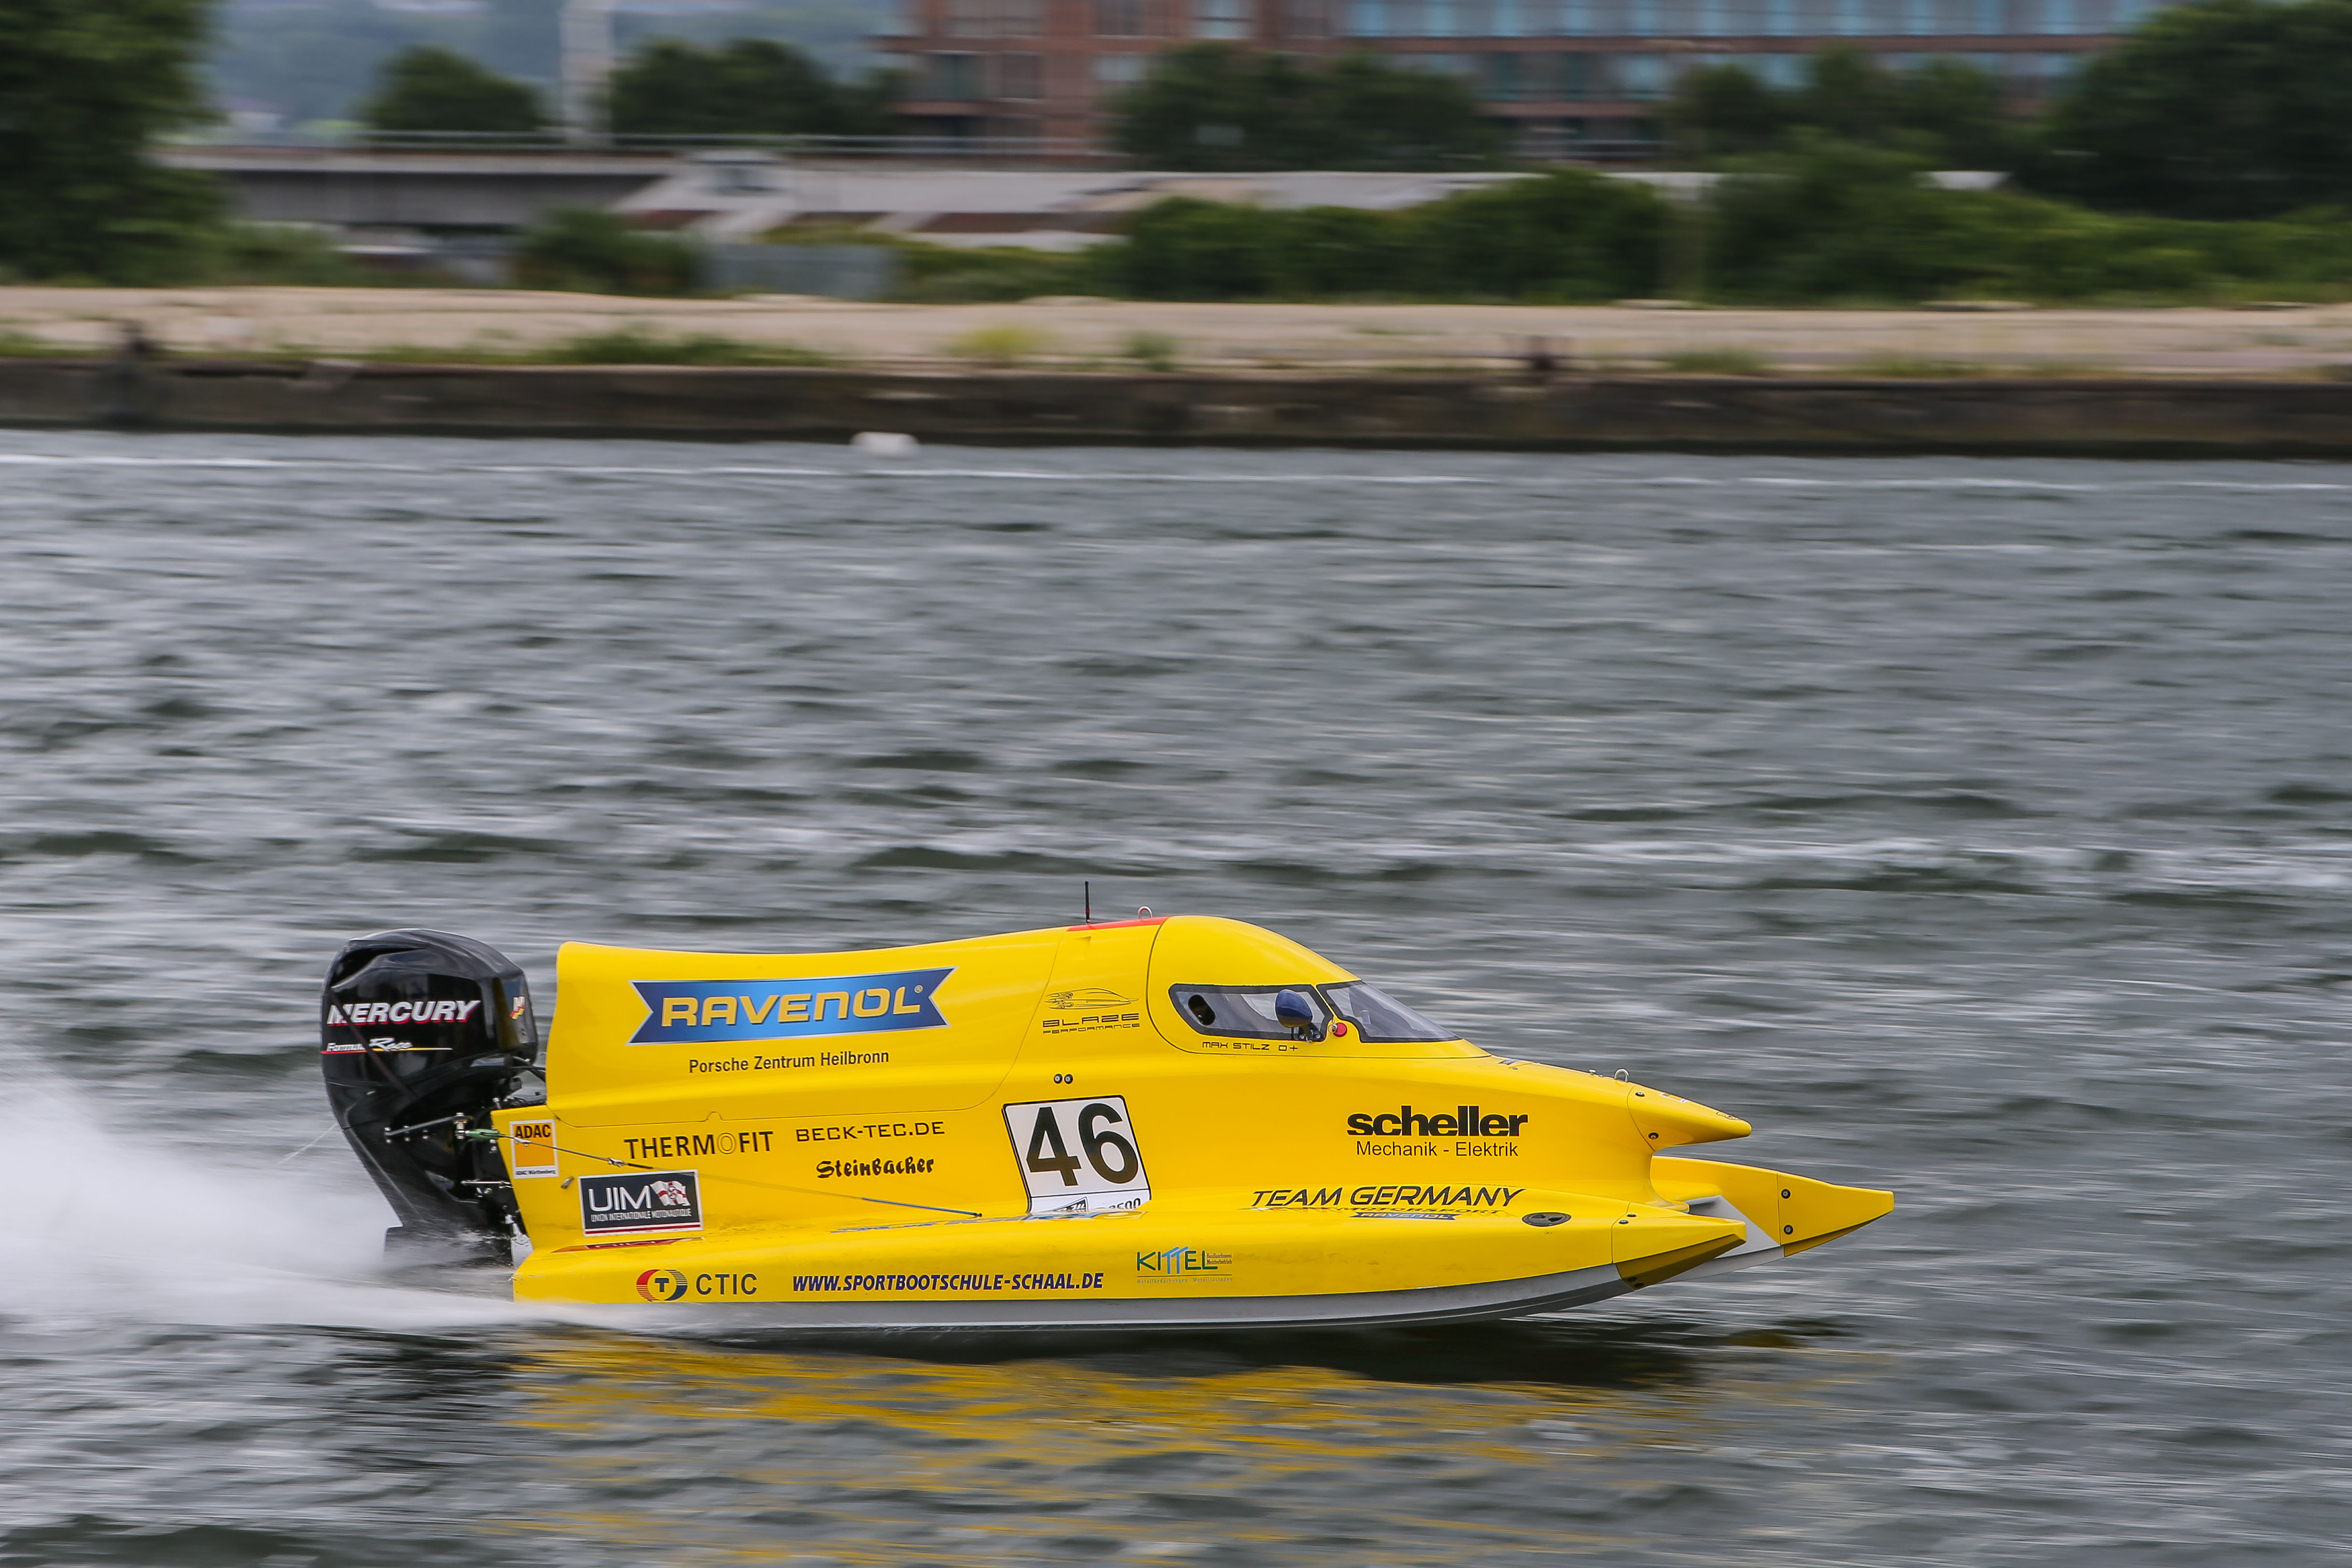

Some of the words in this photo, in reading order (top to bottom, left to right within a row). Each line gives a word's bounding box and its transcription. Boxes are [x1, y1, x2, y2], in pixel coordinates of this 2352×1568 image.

[327, 1000, 481, 1026] MERCURY
[1043, 1013, 1139, 1027] BLAZE
[1043, 1023, 1140, 1035] PERFORMANCE
[689, 1057, 749, 1073] Porsche
[754, 1055, 815, 1070] Zentrum
[821, 1050, 889, 1066] Heilbronn
[1347, 1105, 1528, 1136] scheller
[515, 1124, 551, 1139] ADAC
[796, 1121, 945, 1142] BECK-TEC.DE
[623, 1130, 773, 1159] THERMOFIT
[1026, 1103, 1138, 1187] 46
[1357, 1141, 1438, 1157] Mechanik
[1456, 1141, 1518, 1157] Elektrik
[588, 1185, 652, 1212] UIM
[1253, 1188, 1343, 1207] TEAM
[1351, 1186, 1526, 1207] GERMANY
[1137, 1246, 1218, 1274] KITTEL
[696, 1274, 757, 1295] CTIC
[793, 1273, 1104, 1291] WWW.SPORTBOOTSCHULE-SCHAAL.DE
